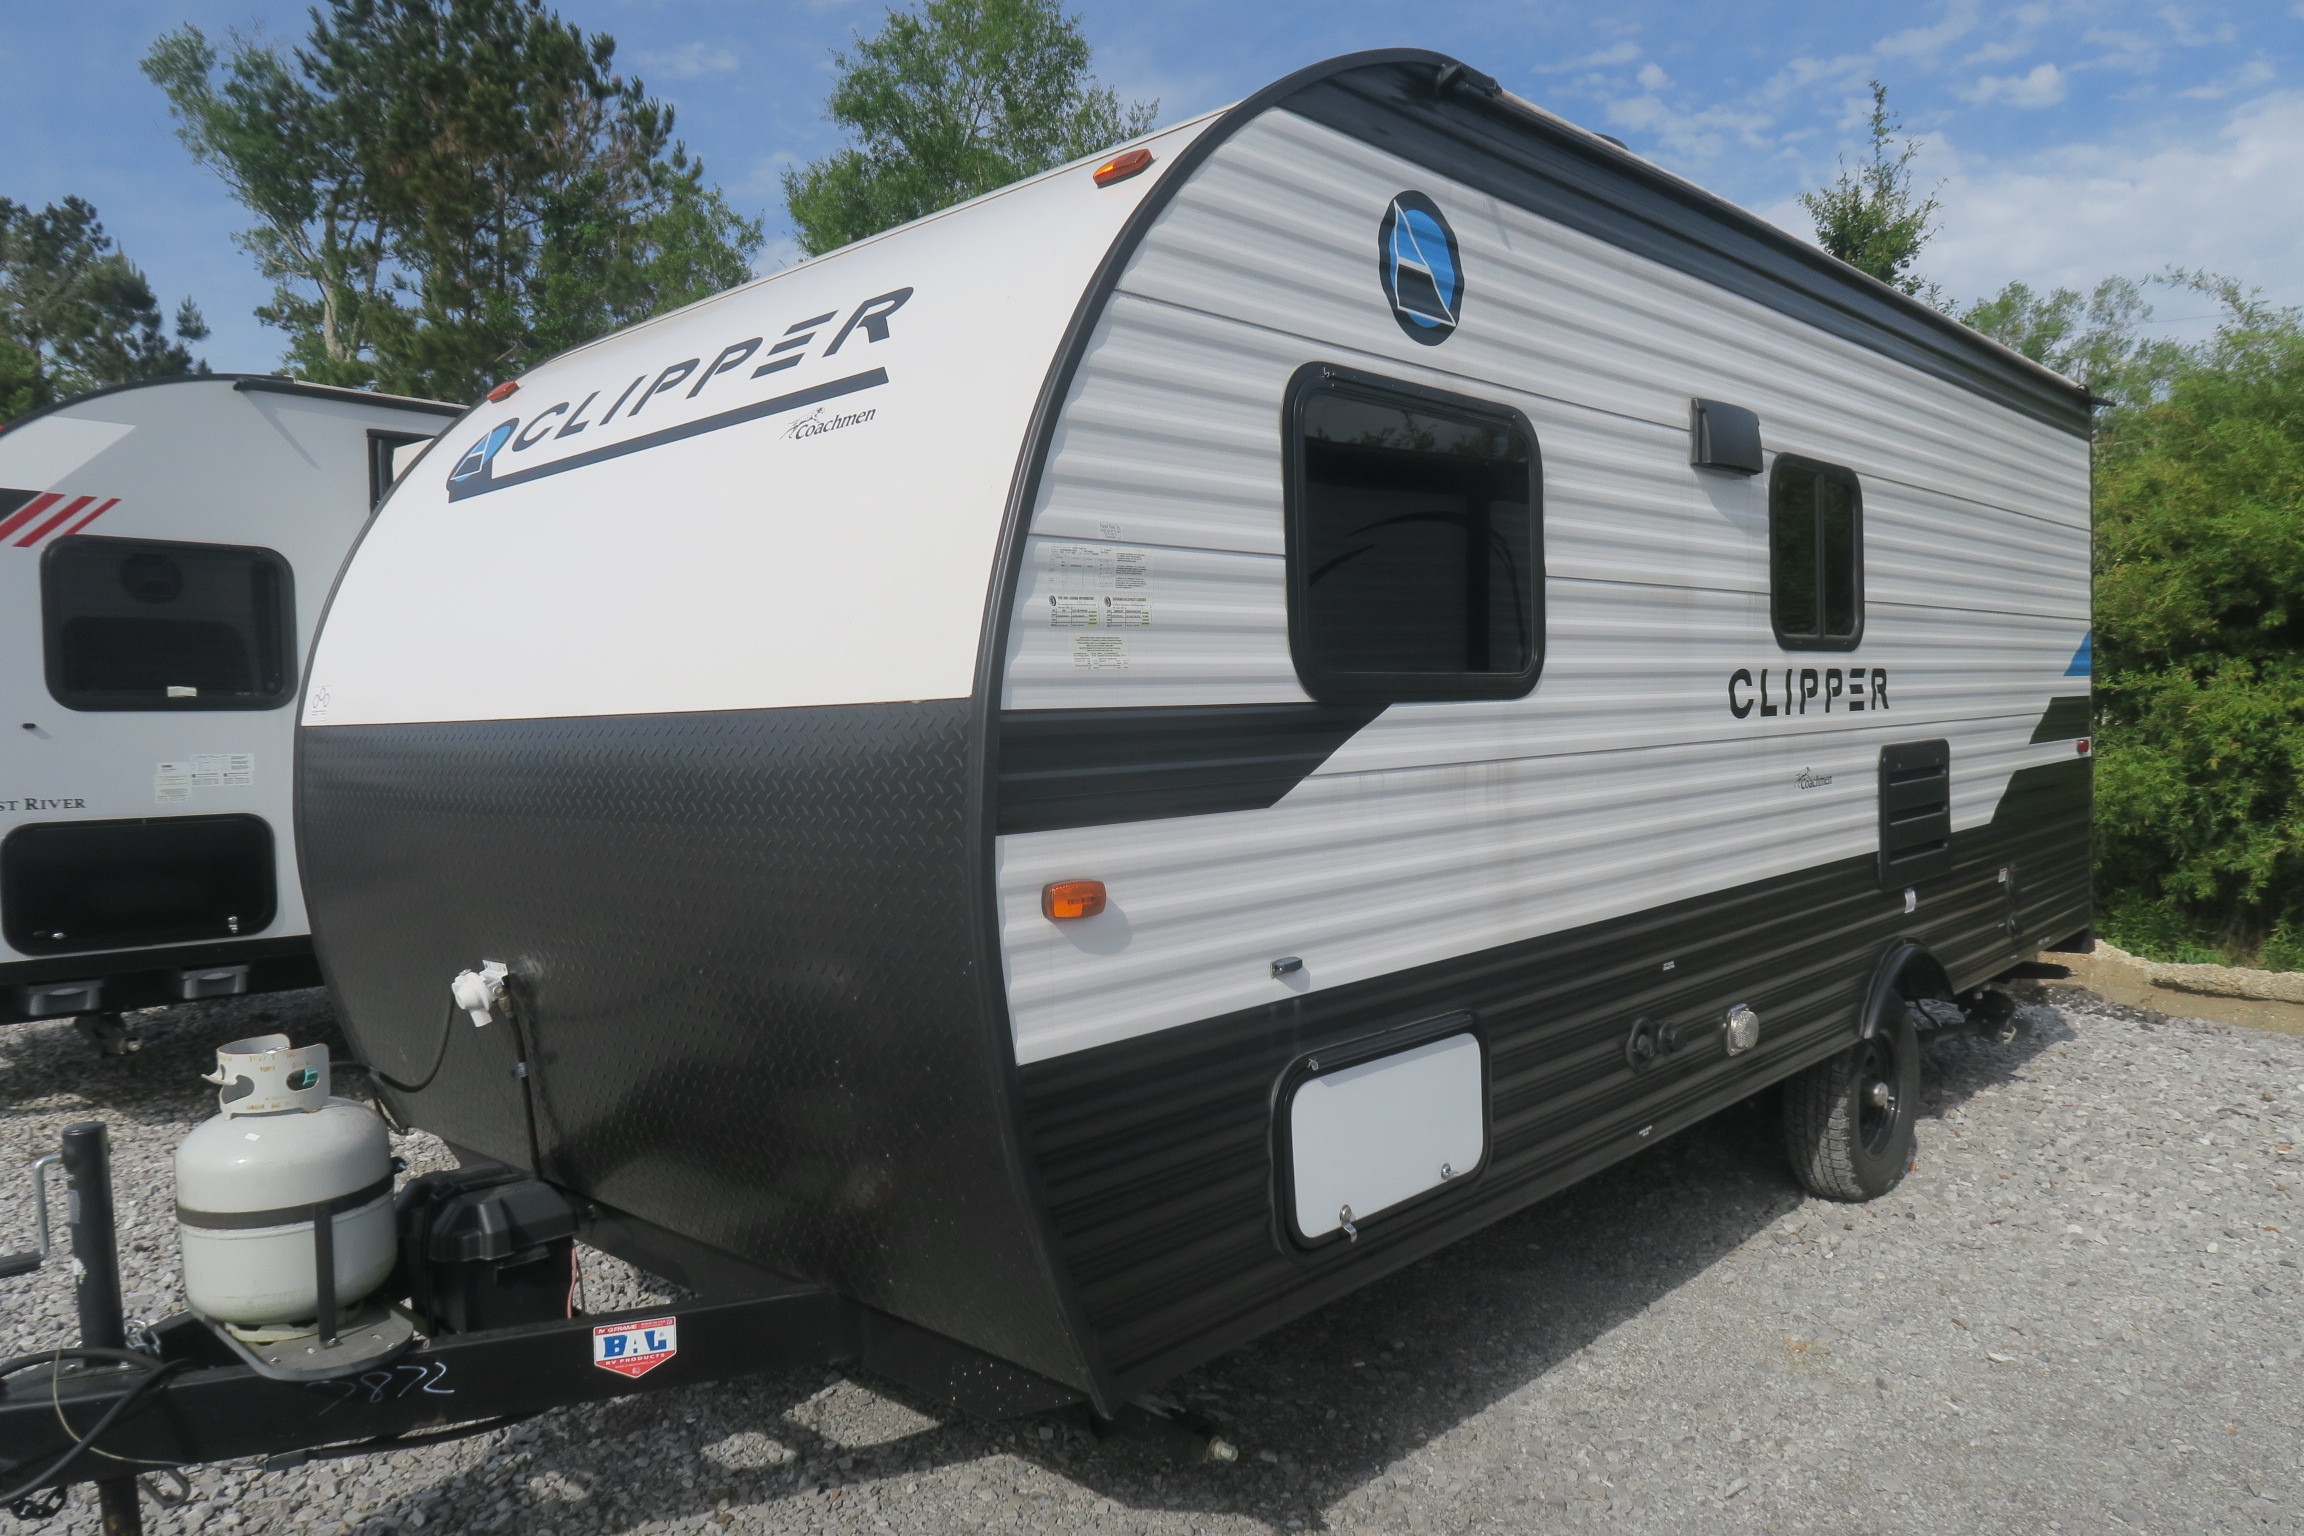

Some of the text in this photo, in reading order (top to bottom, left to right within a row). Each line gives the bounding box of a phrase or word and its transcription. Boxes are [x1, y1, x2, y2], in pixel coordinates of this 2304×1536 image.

[511, 286, 914, 452] CLIPPER
[795, 408, 877, 440] Coachmen
[1728, 668, 1890, 720] CLIPPER
[1800, 774, 1833, 790] Coachmen
[603, 1330, 667, 1358] BAL
[619, 1353, 665, 1363] PRODUCTS
